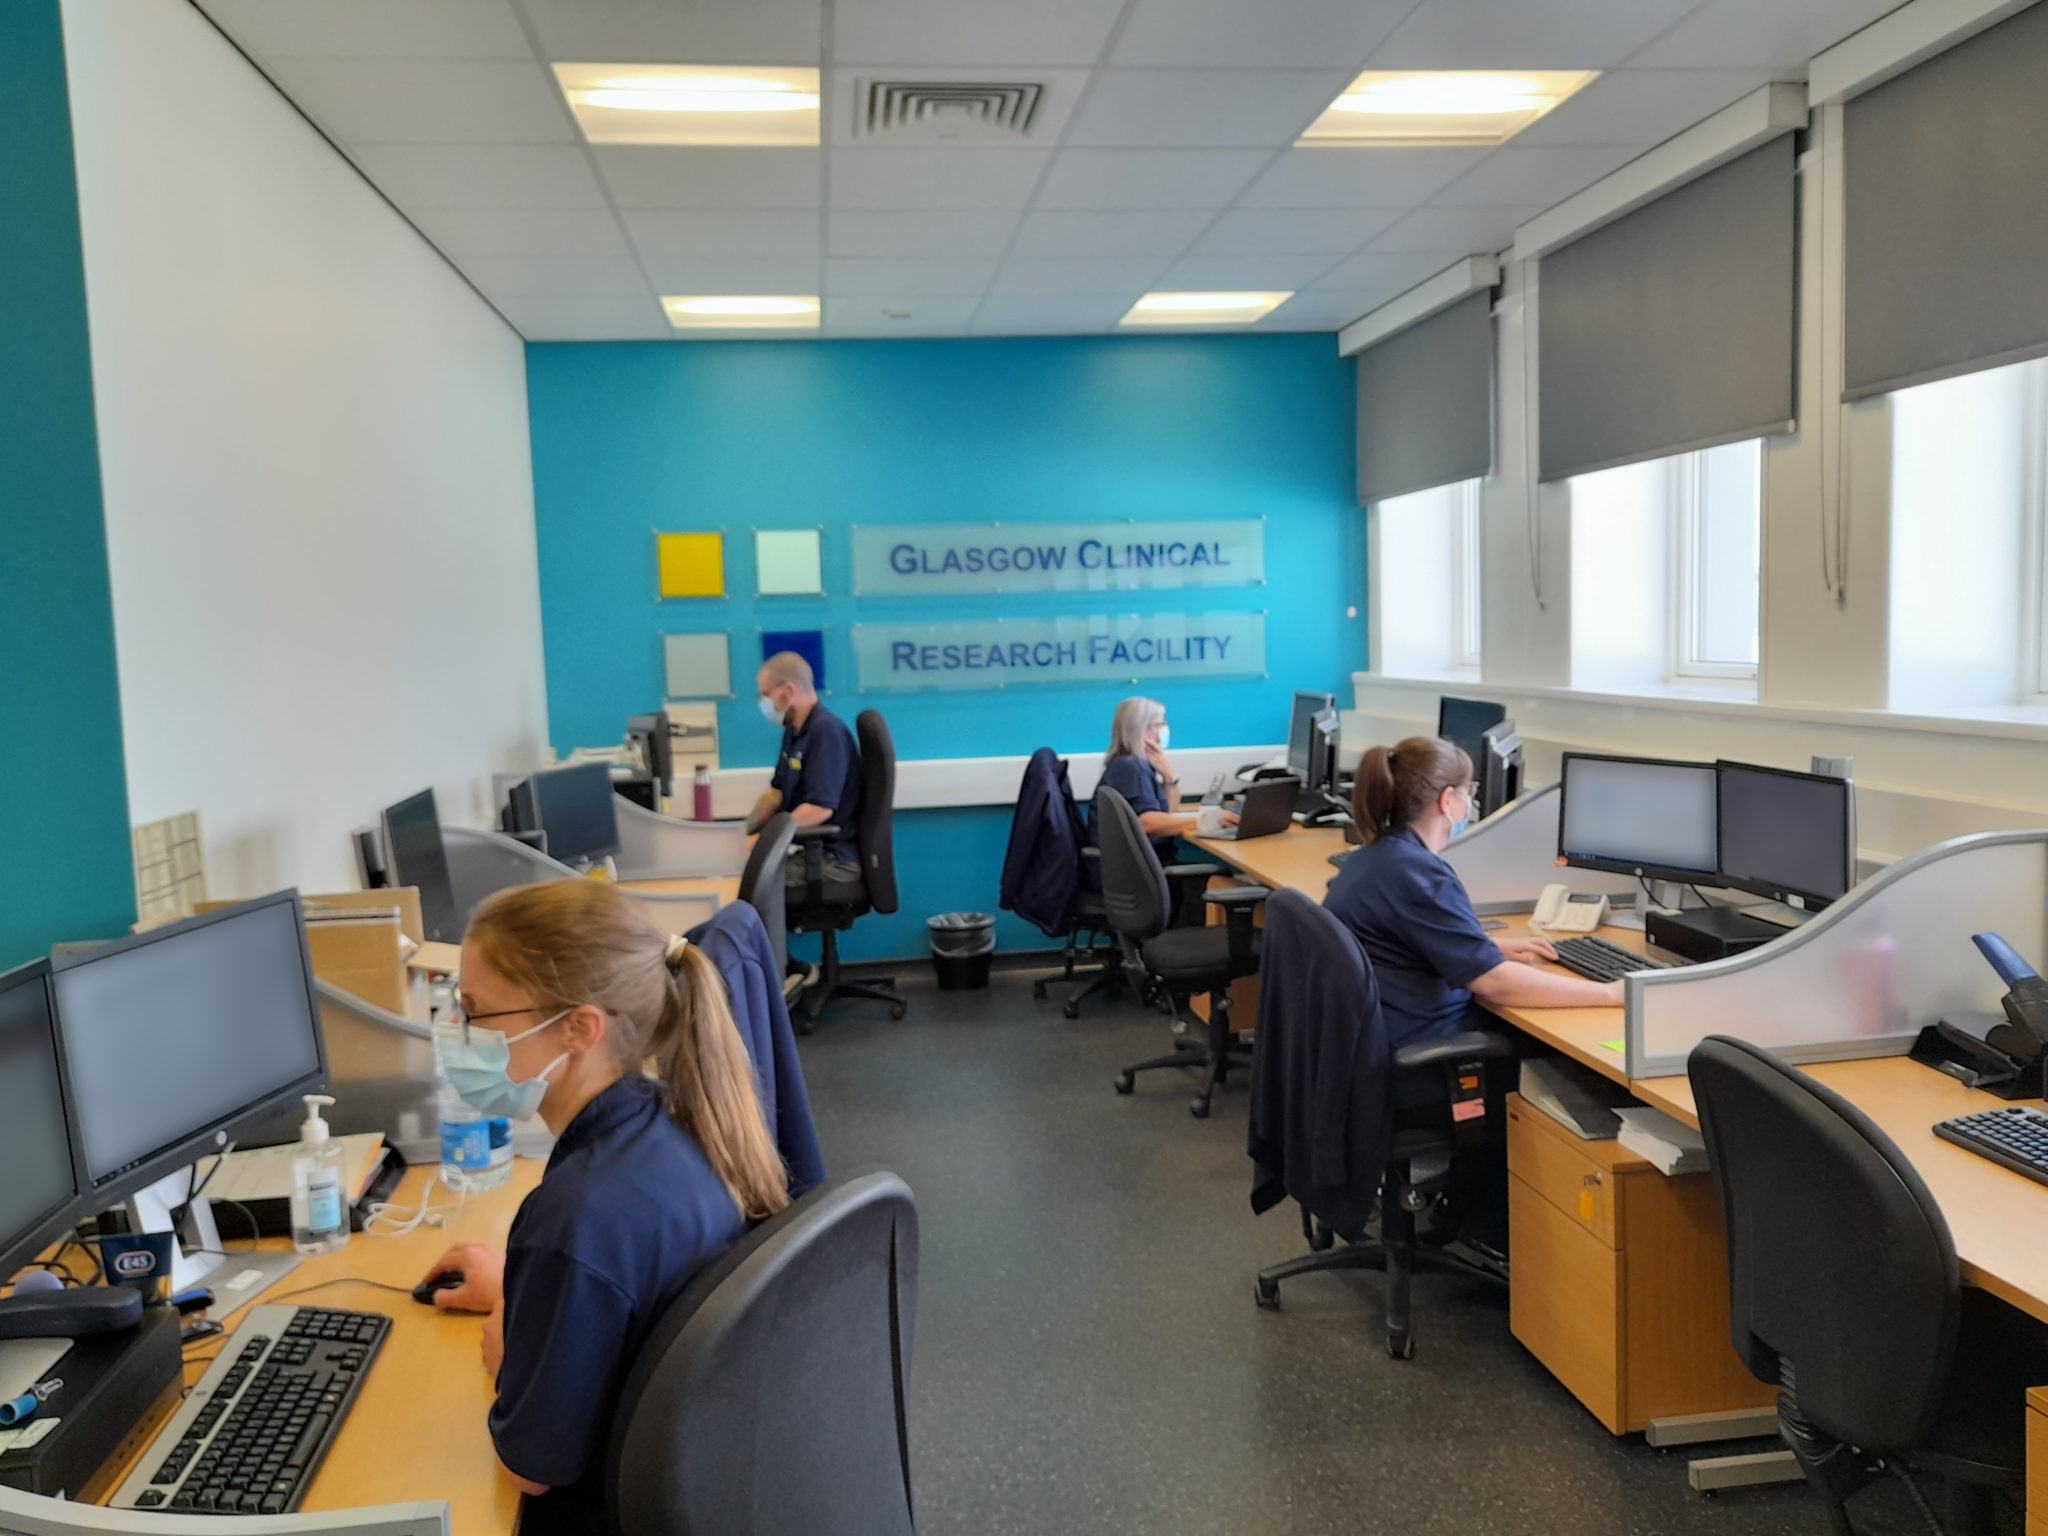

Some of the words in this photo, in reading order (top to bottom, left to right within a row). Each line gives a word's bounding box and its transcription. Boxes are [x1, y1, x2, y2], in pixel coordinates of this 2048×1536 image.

[890, 543, 1067, 575] GLASGOW
[1078, 539, 1231, 569] CLINICAL
[891, 640, 1076, 671] RESEARCH
[1089, 635, 1232, 665] FACILITY
